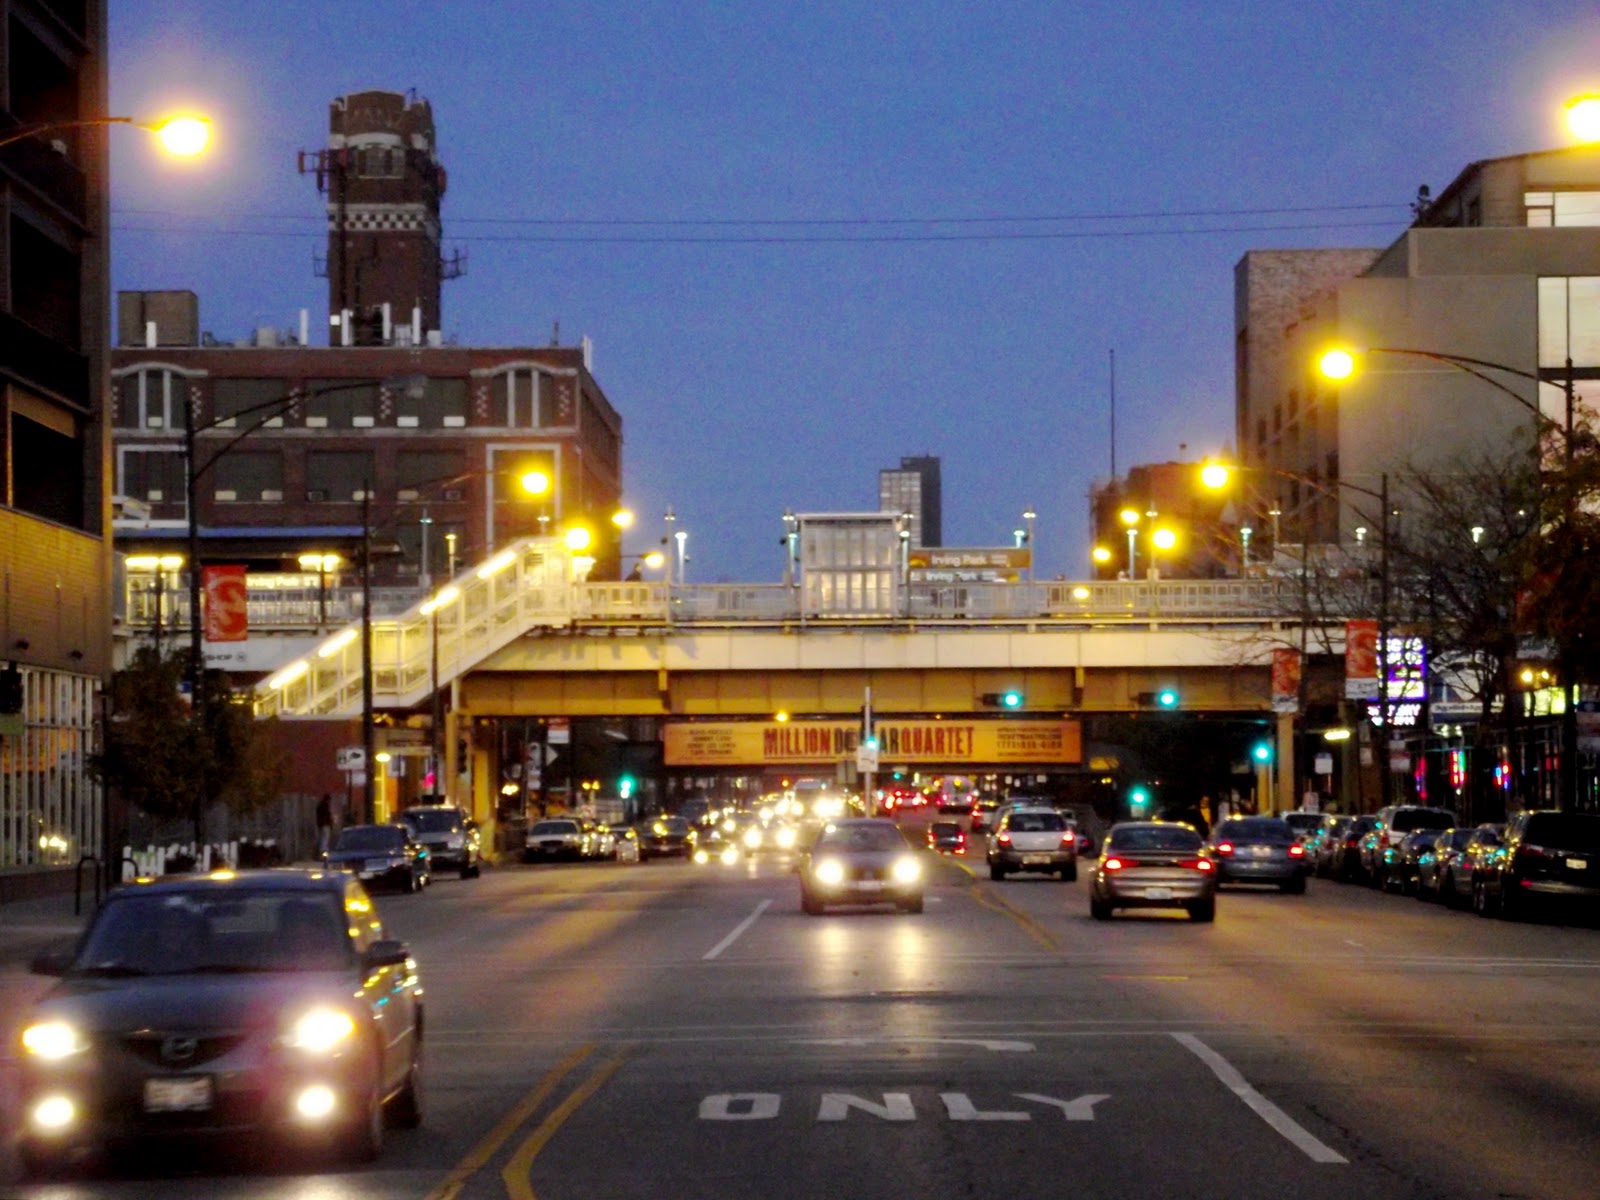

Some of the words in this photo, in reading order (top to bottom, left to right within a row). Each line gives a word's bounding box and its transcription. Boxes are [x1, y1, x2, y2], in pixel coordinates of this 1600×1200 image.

[931, 554, 960, 567] Irving
[962, 554, 987, 565] Park
[763, 728, 830, 755] MILLION
[834, 727, 899, 754] DOAR
[901, 726, 974, 755] QUARTET
[699, 1092, 1113, 1121] ONLY
